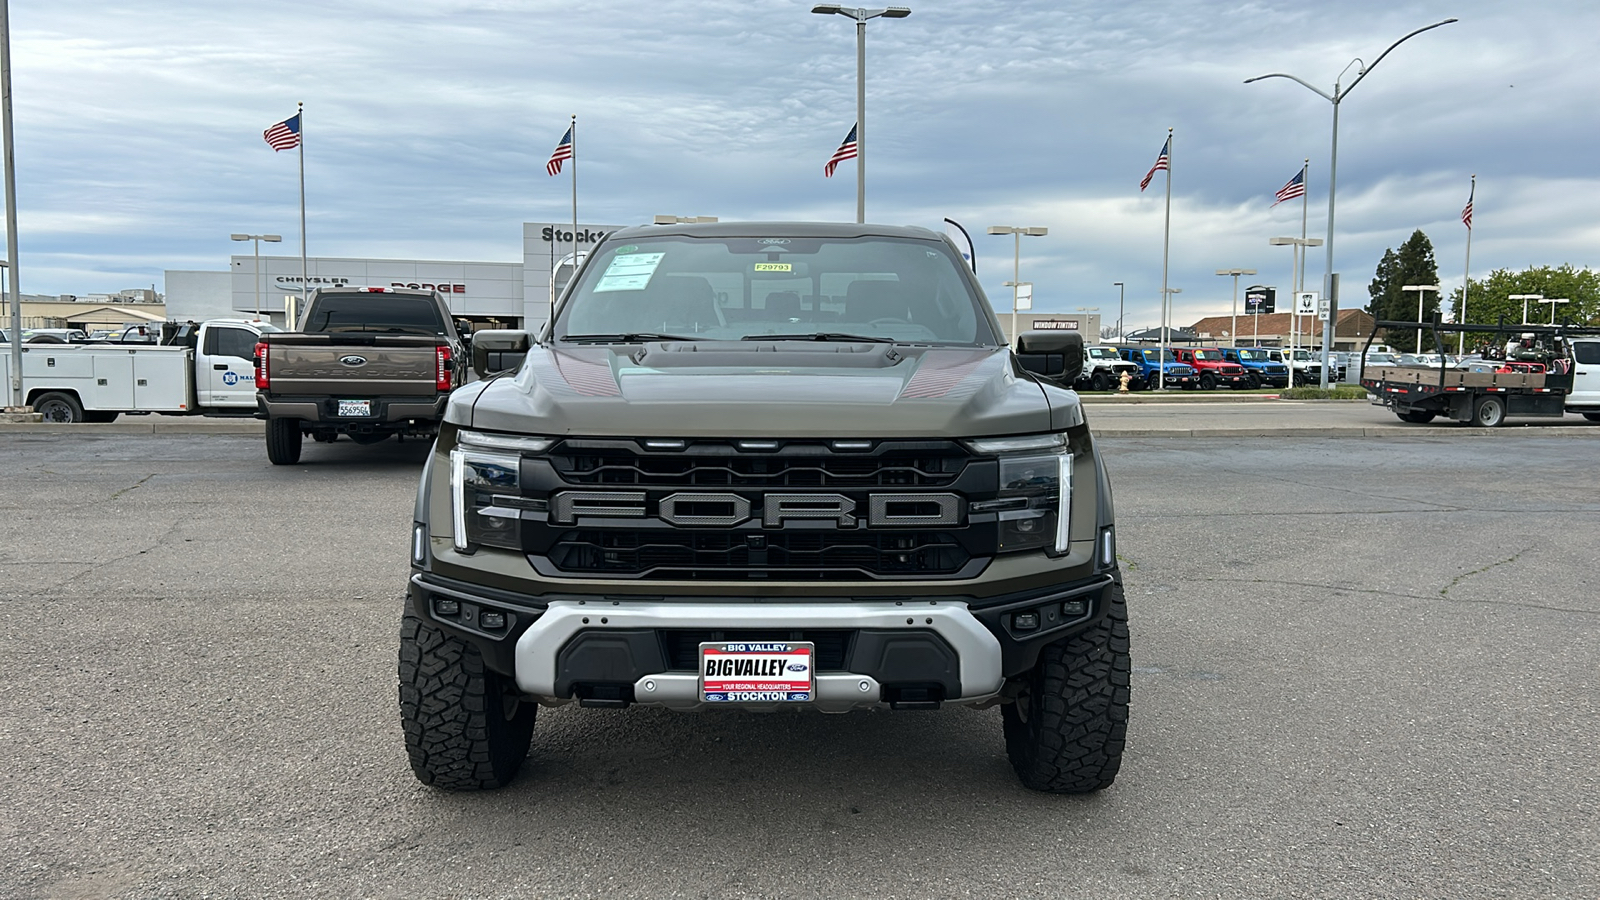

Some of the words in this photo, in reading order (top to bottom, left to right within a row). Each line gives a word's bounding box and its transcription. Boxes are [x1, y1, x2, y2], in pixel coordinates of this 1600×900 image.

[1034, 321, 1057, 329] WINDOW
[1057, 321, 1078, 329] TINTING
[549, 490, 965, 529] FORD
[706, 659, 788, 676] BIGVALLEY
[727, 692, 788, 700] STOCKTON
